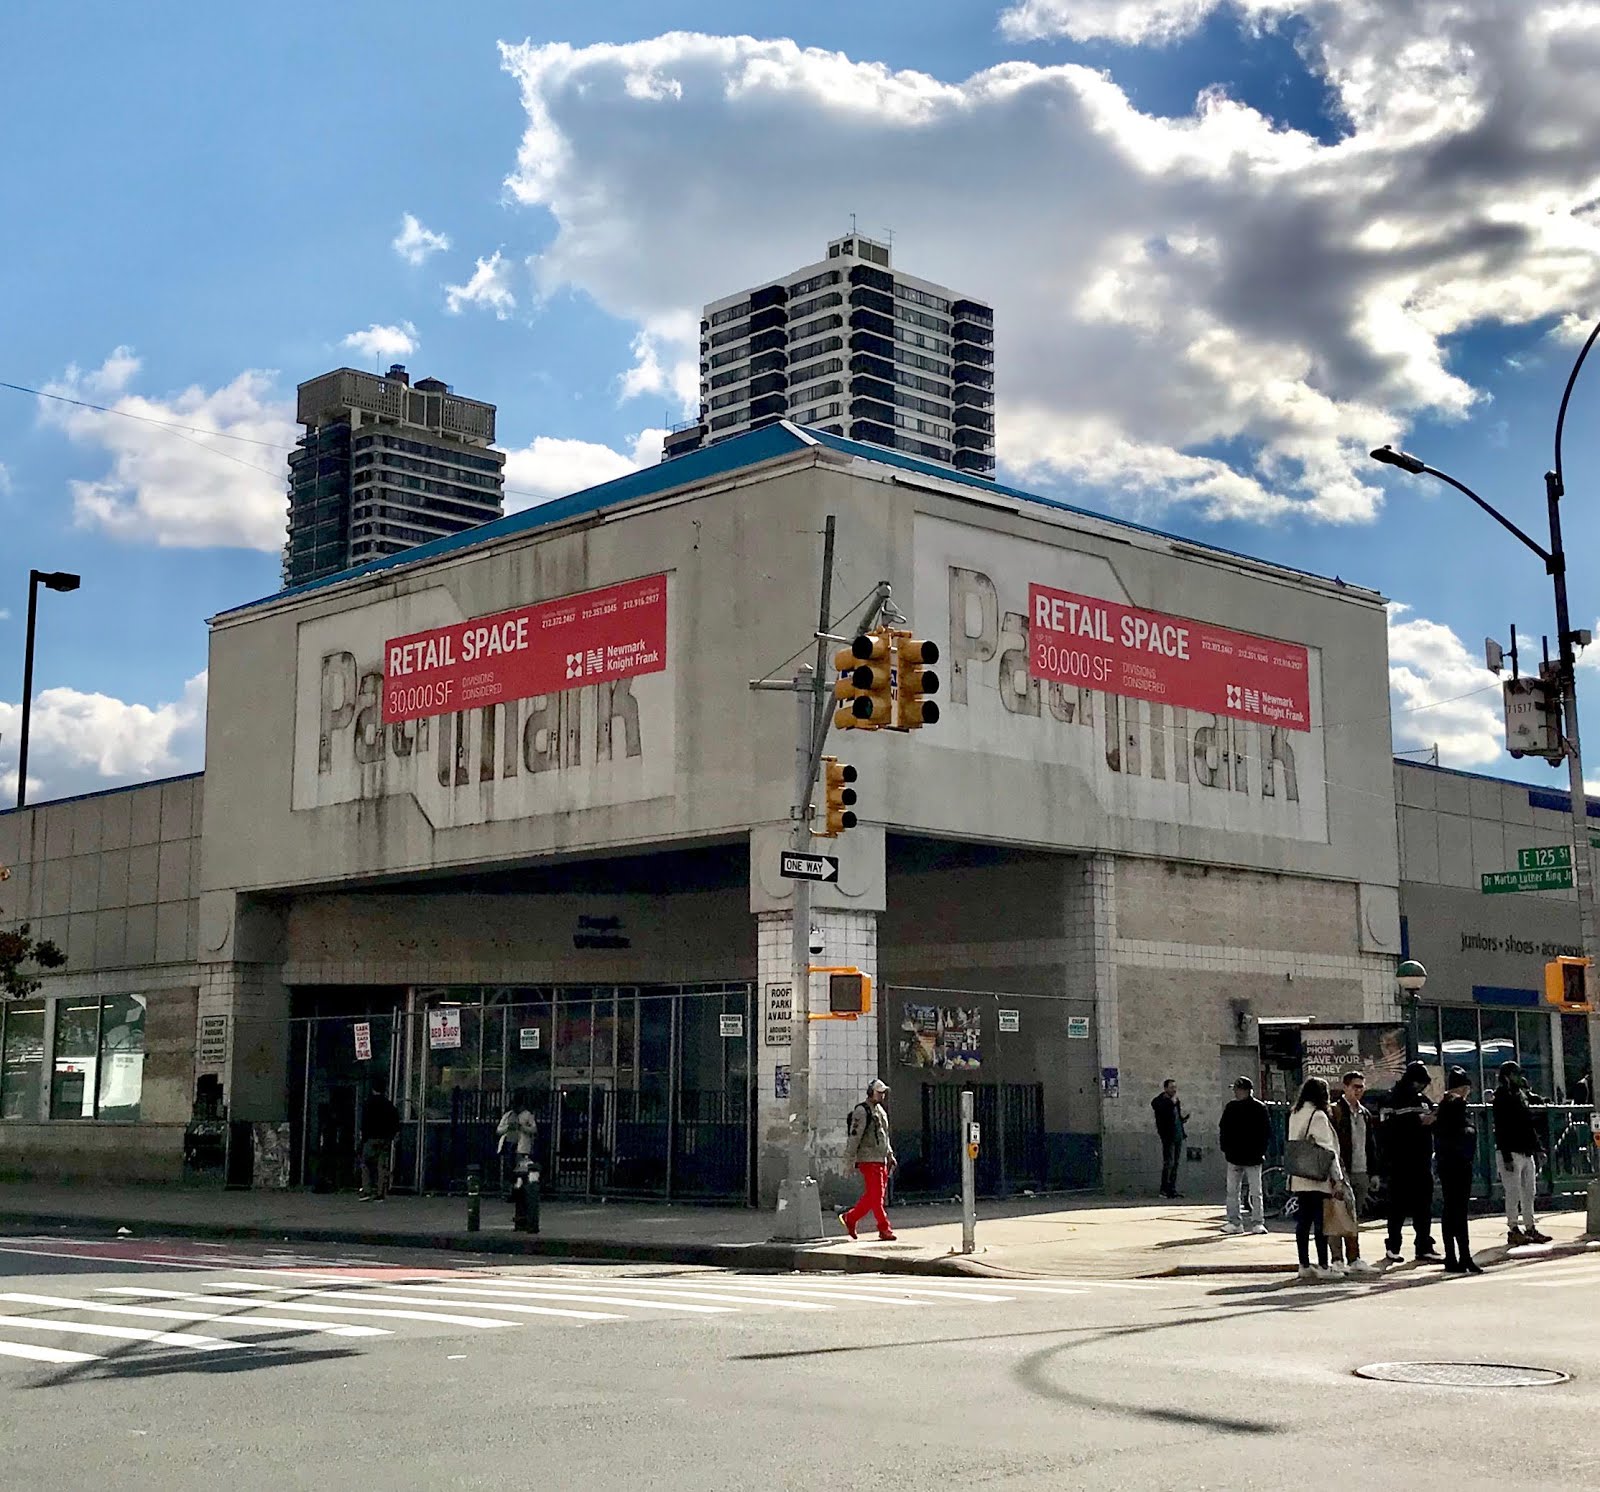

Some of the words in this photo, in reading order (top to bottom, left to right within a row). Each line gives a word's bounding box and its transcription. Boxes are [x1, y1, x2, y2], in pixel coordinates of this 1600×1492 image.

[1035, 594, 1114, 643] RETAIL
[1120, 615, 1190, 660] SPACE
[390, 635, 456, 677] RETAIL
[462, 617, 529, 662] SPACE
[607, 639, 645, 657] Newmark
[607, 655, 633, 671] Knight
[635, 650, 659, 665] Frank
[1037, 644, 1090, 676] 30,000
[1093, 655, 1113, 682] SF
[389, 684, 433, 715] 30,000
[435, 680, 454, 705] SF
[1262, 692, 1294, 708] Newmark
[1262, 704, 1285, 719] Knight
[1286, 709, 1304, 722] Frank
[786, 859, 803, 871] ONE
[806, 861, 823, 873] WAY
[1522, 851, 1530, 867] E
[1535, 849, 1555, 866] 125
[1559, 848, 1568, 858] St
[1483, 875, 1491, 886] Dr
[1494, 874, 1517, 886] Martin
[1519, 872, 1543, 884] Luther
[1545, 871, 1562, 883] King
[1564, 870, 1572, 881] Jr
[1461, 931, 1497, 952] juniors
[1505, 934, 1535, 954] shoes
[771, 988, 791, 997] ROOF
[771, 1000, 791, 1008] PARKI
[1307, 1046, 1334, 1054] PHONE
[1333, 1038, 1354, 1046] YOUR
[1307, 1056, 1331, 1064] SAVE
[1334, 1055, 1360, 1064] YOUR
[1308, 1064, 1342, 1073] MONEY
